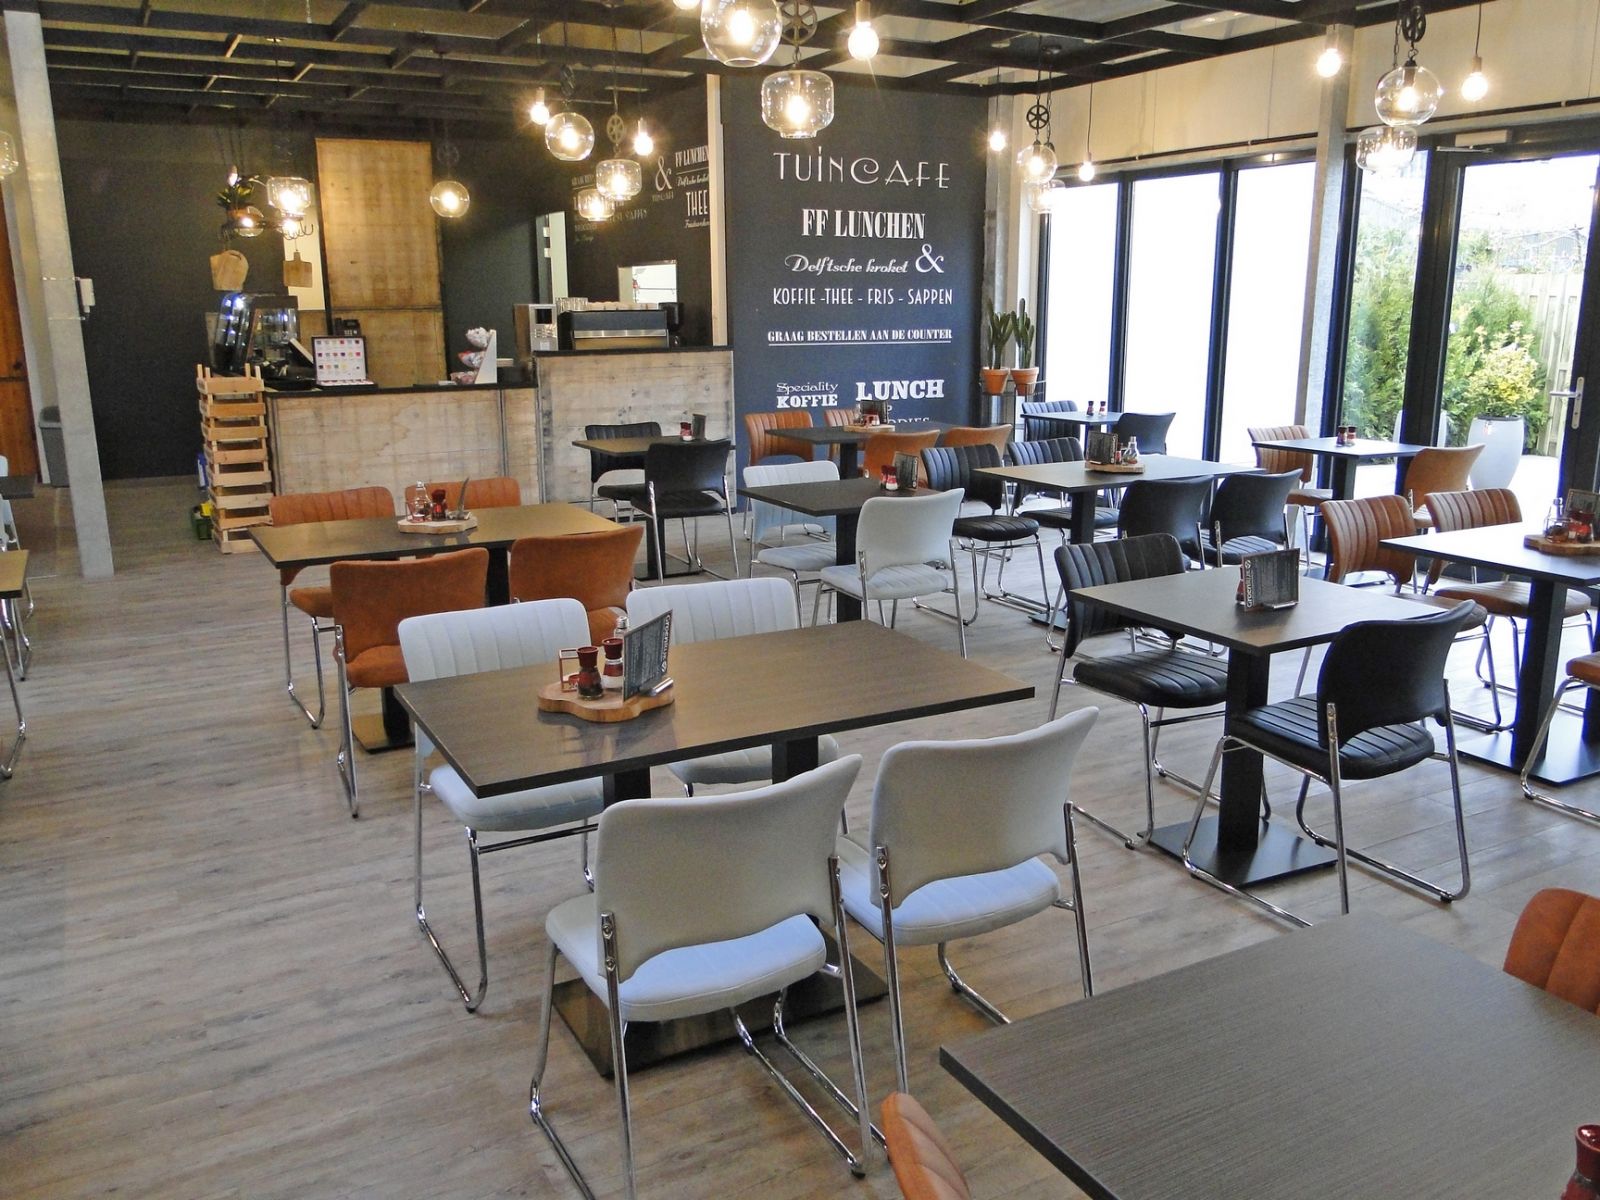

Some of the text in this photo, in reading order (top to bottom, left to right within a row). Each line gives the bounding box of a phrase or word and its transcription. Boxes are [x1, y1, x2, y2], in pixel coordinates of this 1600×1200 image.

[655, 156, 672, 191] &
[686, 190, 708, 216] THEE
[801, 208, 926, 239] FF LUNCHEN
[784, 243, 945, 276] Delftsche kroket &
[773, 287, 816, 305] KOFFIE
[867, 288, 895, 305] FRIS
[907, 288, 953, 305] SAPPEN
[767, 328, 953, 342] GRAAG BESTELLEN AAN DE COUNTER
[776, 381, 839, 395] Speciality
[855, 379, 945, 401] LUNCH
[776, 394, 838, 409] KOFFIE
